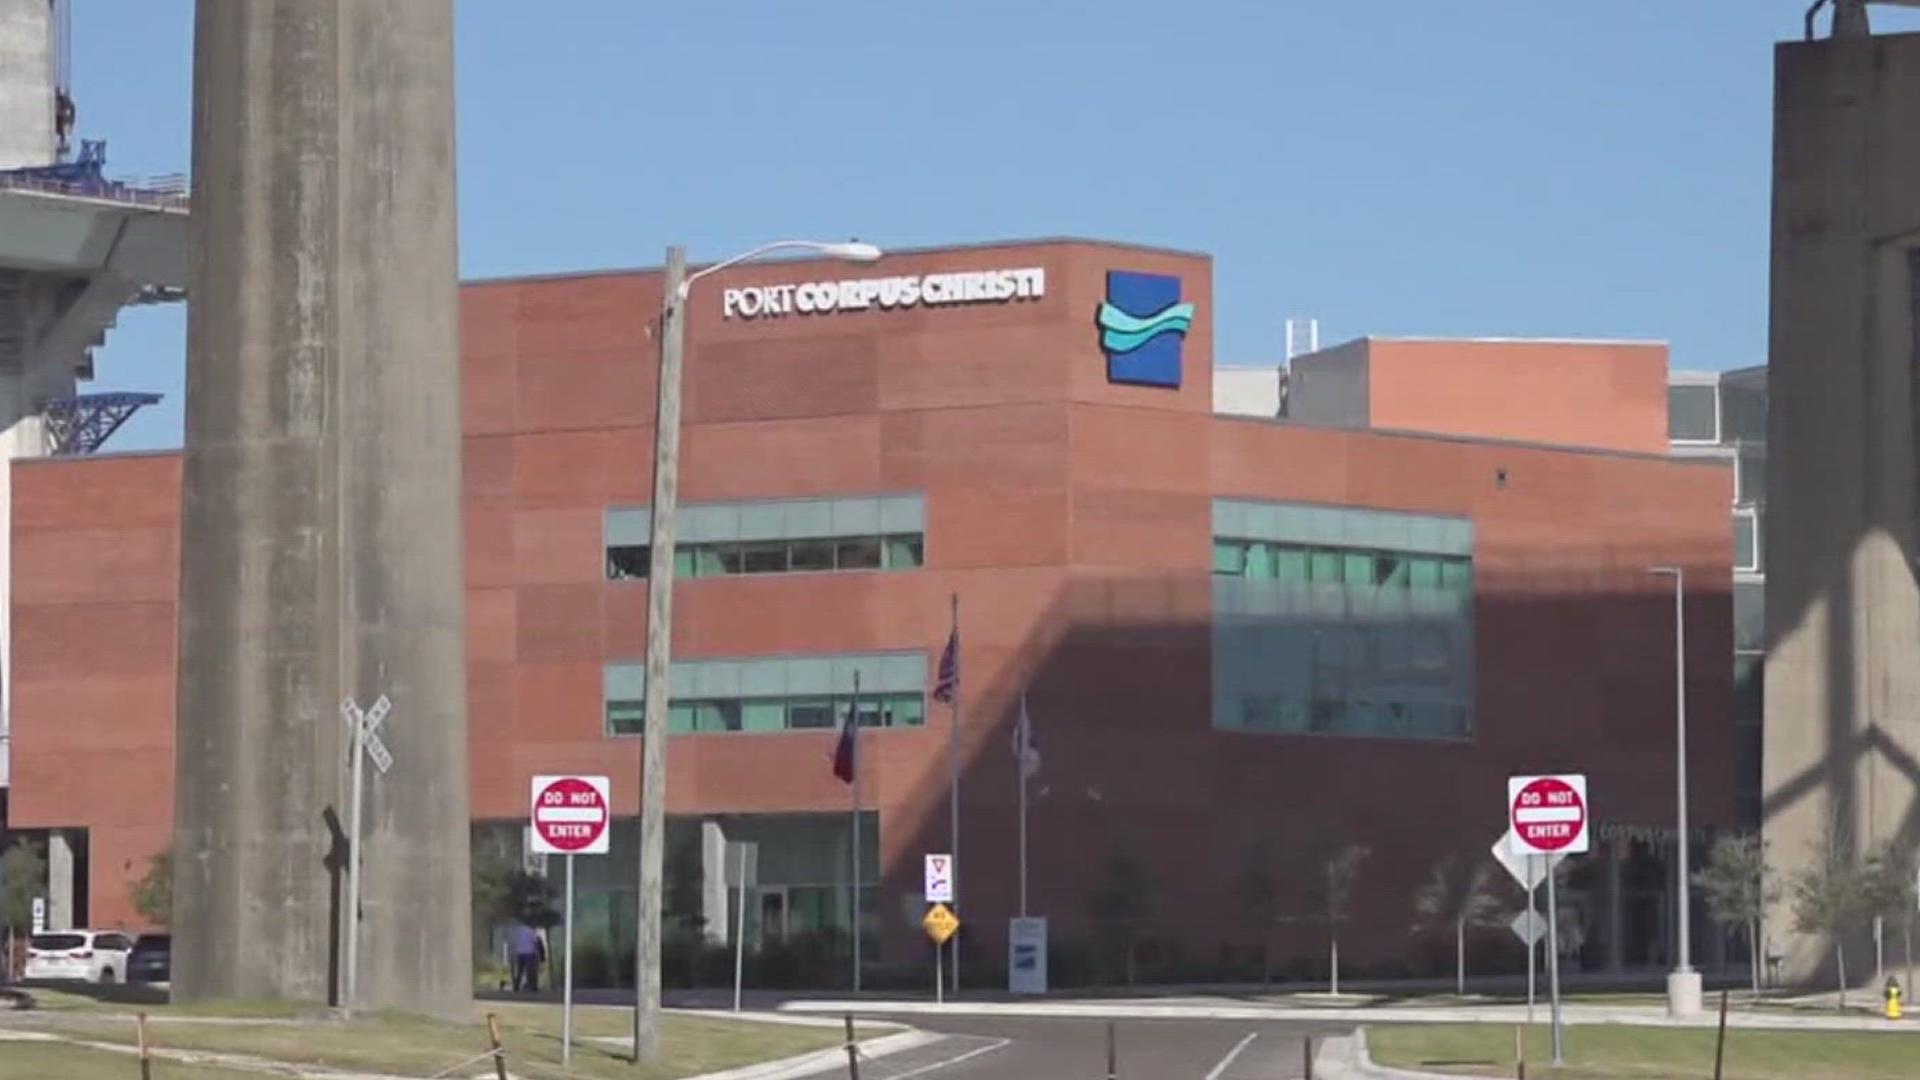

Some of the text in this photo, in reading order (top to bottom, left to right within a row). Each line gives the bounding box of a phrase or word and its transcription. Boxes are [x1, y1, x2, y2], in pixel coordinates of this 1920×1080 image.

[724, 269, 1044, 318] PORT CORPUS CHRISTI
[545, 791, 595, 805] DO NOT
[1521, 791, 1573, 805] DO NOT
[549, 825, 592, 838] ENTER
[1527, 825, 1571, 839] ENTER
